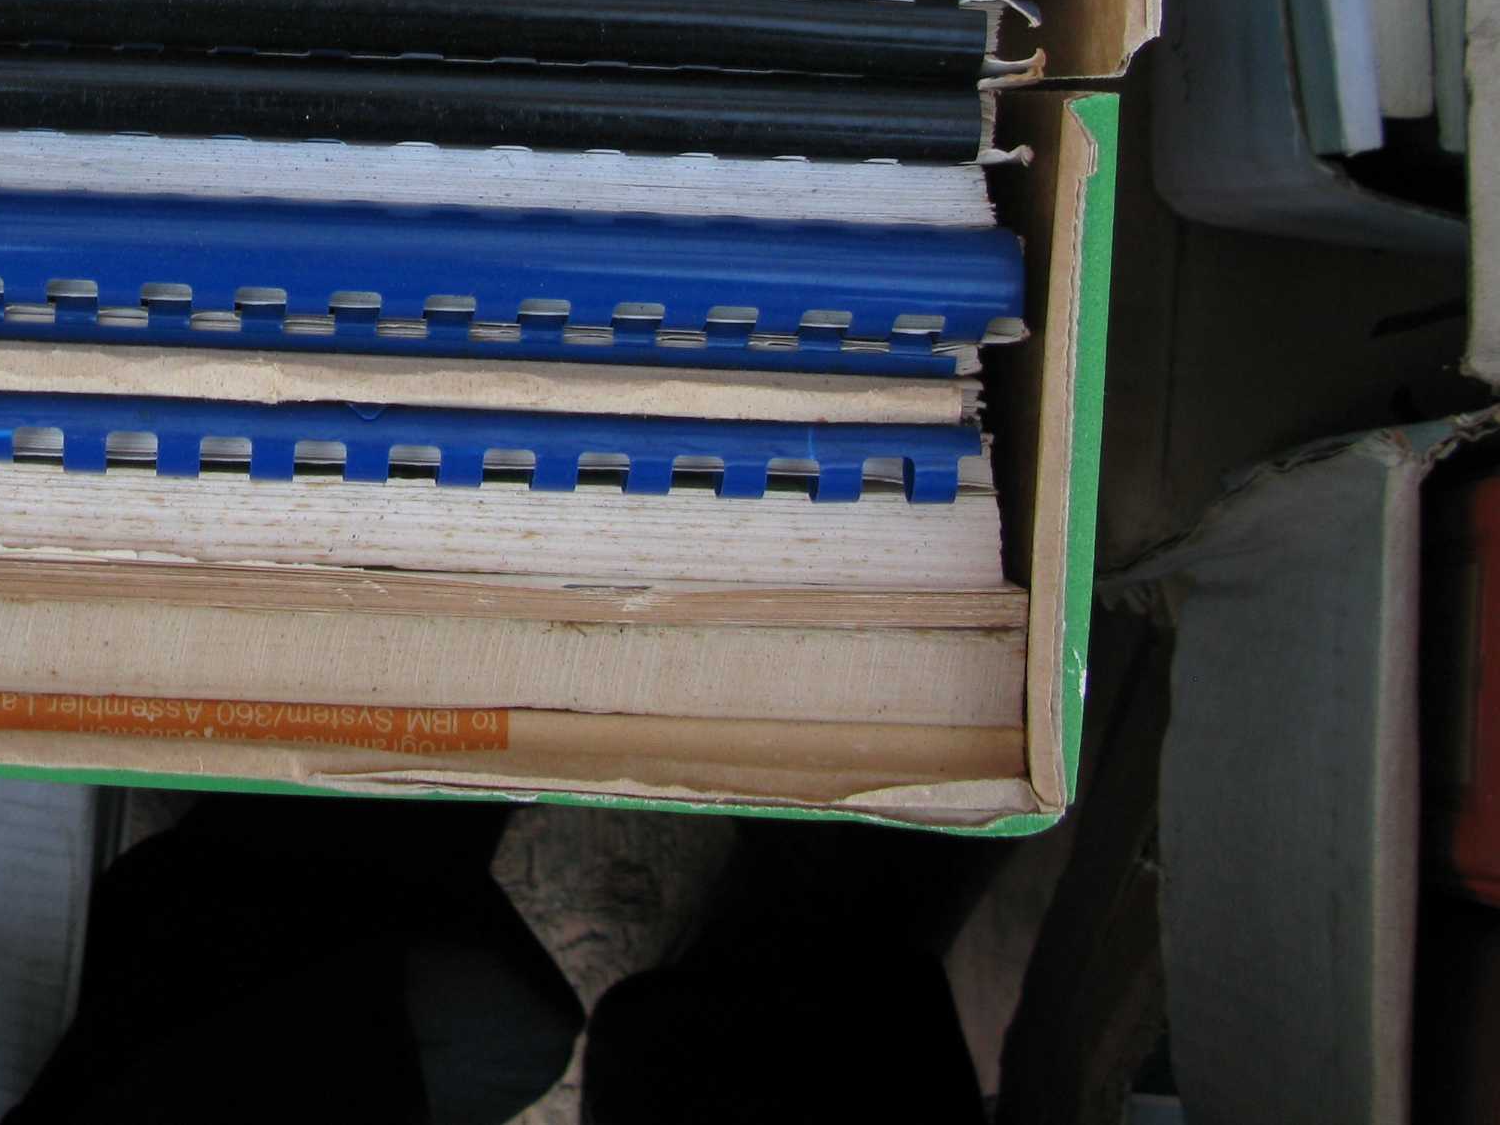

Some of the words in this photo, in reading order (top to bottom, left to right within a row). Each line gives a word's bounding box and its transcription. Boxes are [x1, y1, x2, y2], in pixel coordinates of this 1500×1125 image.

[48, 694, 202, 724] Assembler
[216, 702, 394, 733] System/360
[407, 708, 459, 735] IBM
[470, 709, 498, 733] to
